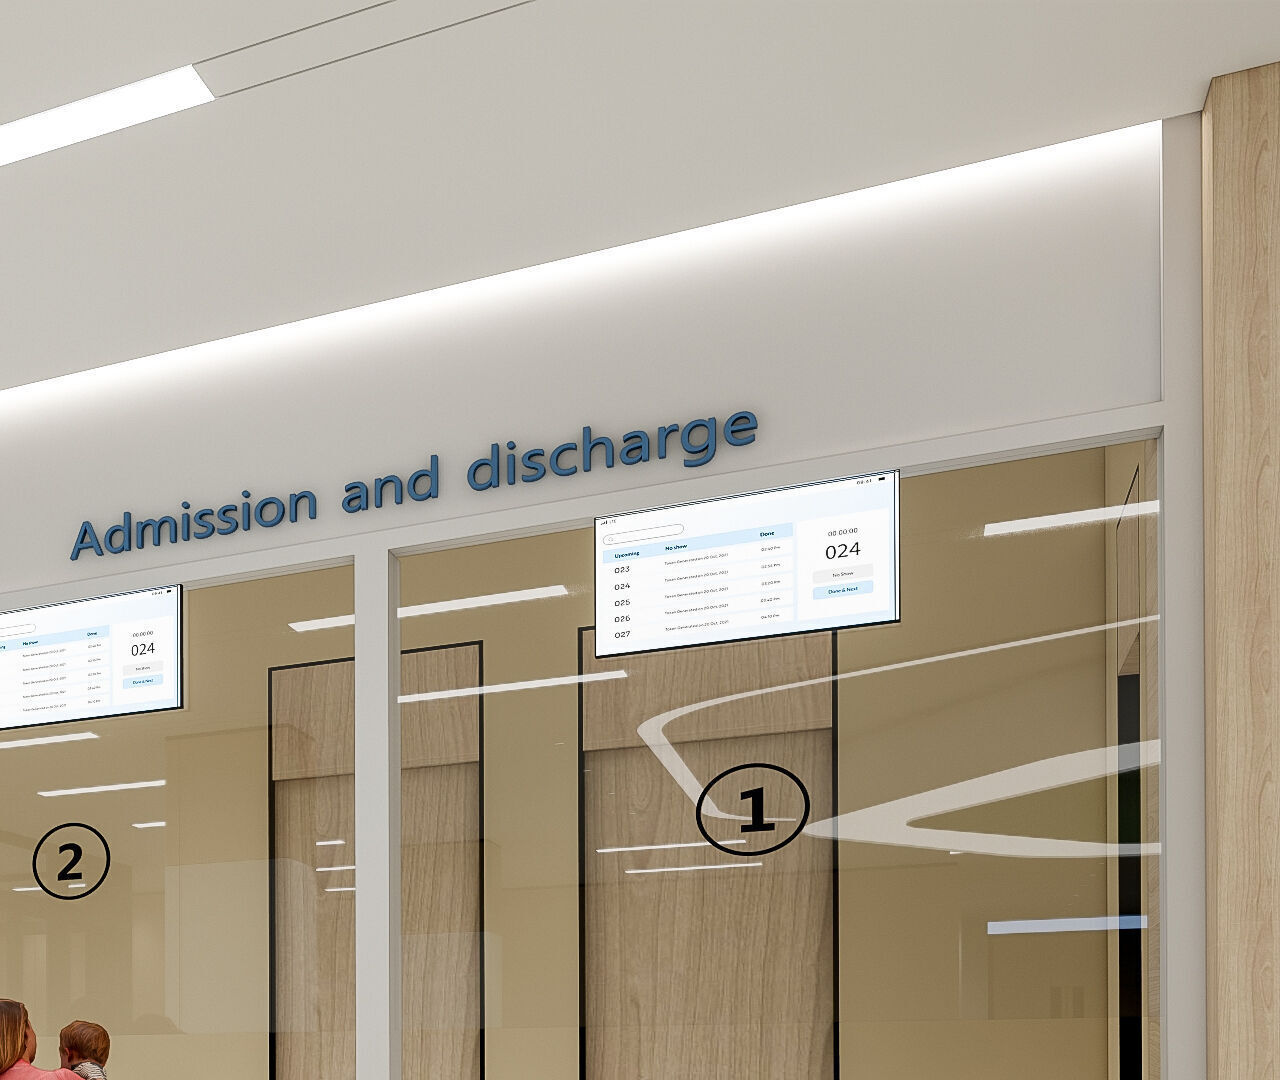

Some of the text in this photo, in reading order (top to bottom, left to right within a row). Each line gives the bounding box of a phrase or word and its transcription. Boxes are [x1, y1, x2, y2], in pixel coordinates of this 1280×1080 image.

[69, 410, 758, 561] Admission and discharge
[825, 541, 861, 560] 024
[614, 565, 630, 574] 023
[614, 582, 631, 591] 024
[614, 599, 631, 607] 025
[614, 615, 631, 623] 026
[614, 630, 631, 639] 027
[131, 642, 155, 657] 024
[740, 787, 775, 833] 1
[57, 843, 82, 881] 2
